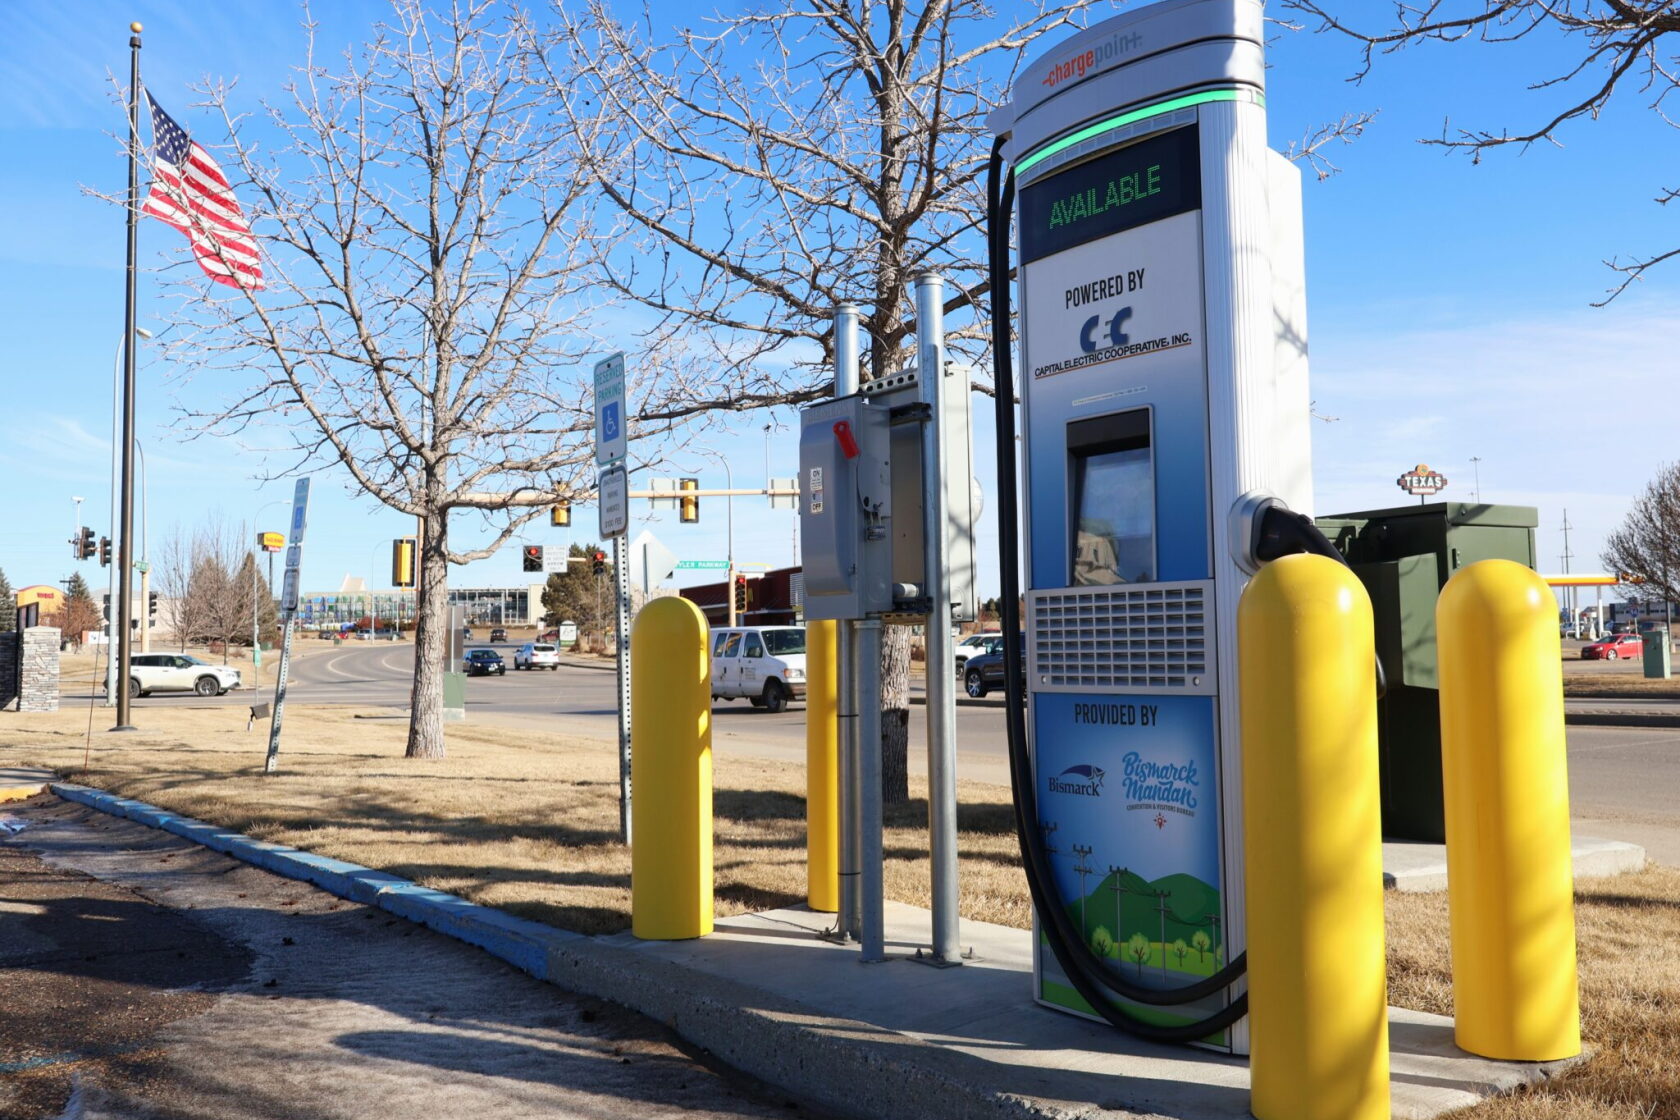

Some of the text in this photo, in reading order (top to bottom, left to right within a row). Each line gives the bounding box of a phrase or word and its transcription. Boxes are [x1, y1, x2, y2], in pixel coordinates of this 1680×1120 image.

[1050, 165, 1160, 229] AVAILABLE
[1065, 268, 1145, 309] POWERED BY
[1034, 362, 1064, 377] CAPITAL
[1064, 351, 1103, 369] ELECTRIC
[1172, 333, 1192, 345] INC.
[596, 363, 622, 387] RESERVED
[1405, 476, 1442, 487] TEXAS
[1074, 703, 1157, 727] PROVIDED BY
[1121, 751, 1199, 786] Bismarck
[1048, 777, 1100, 796] Bismarck
[1121, 778, 1198, 808] Mandan
